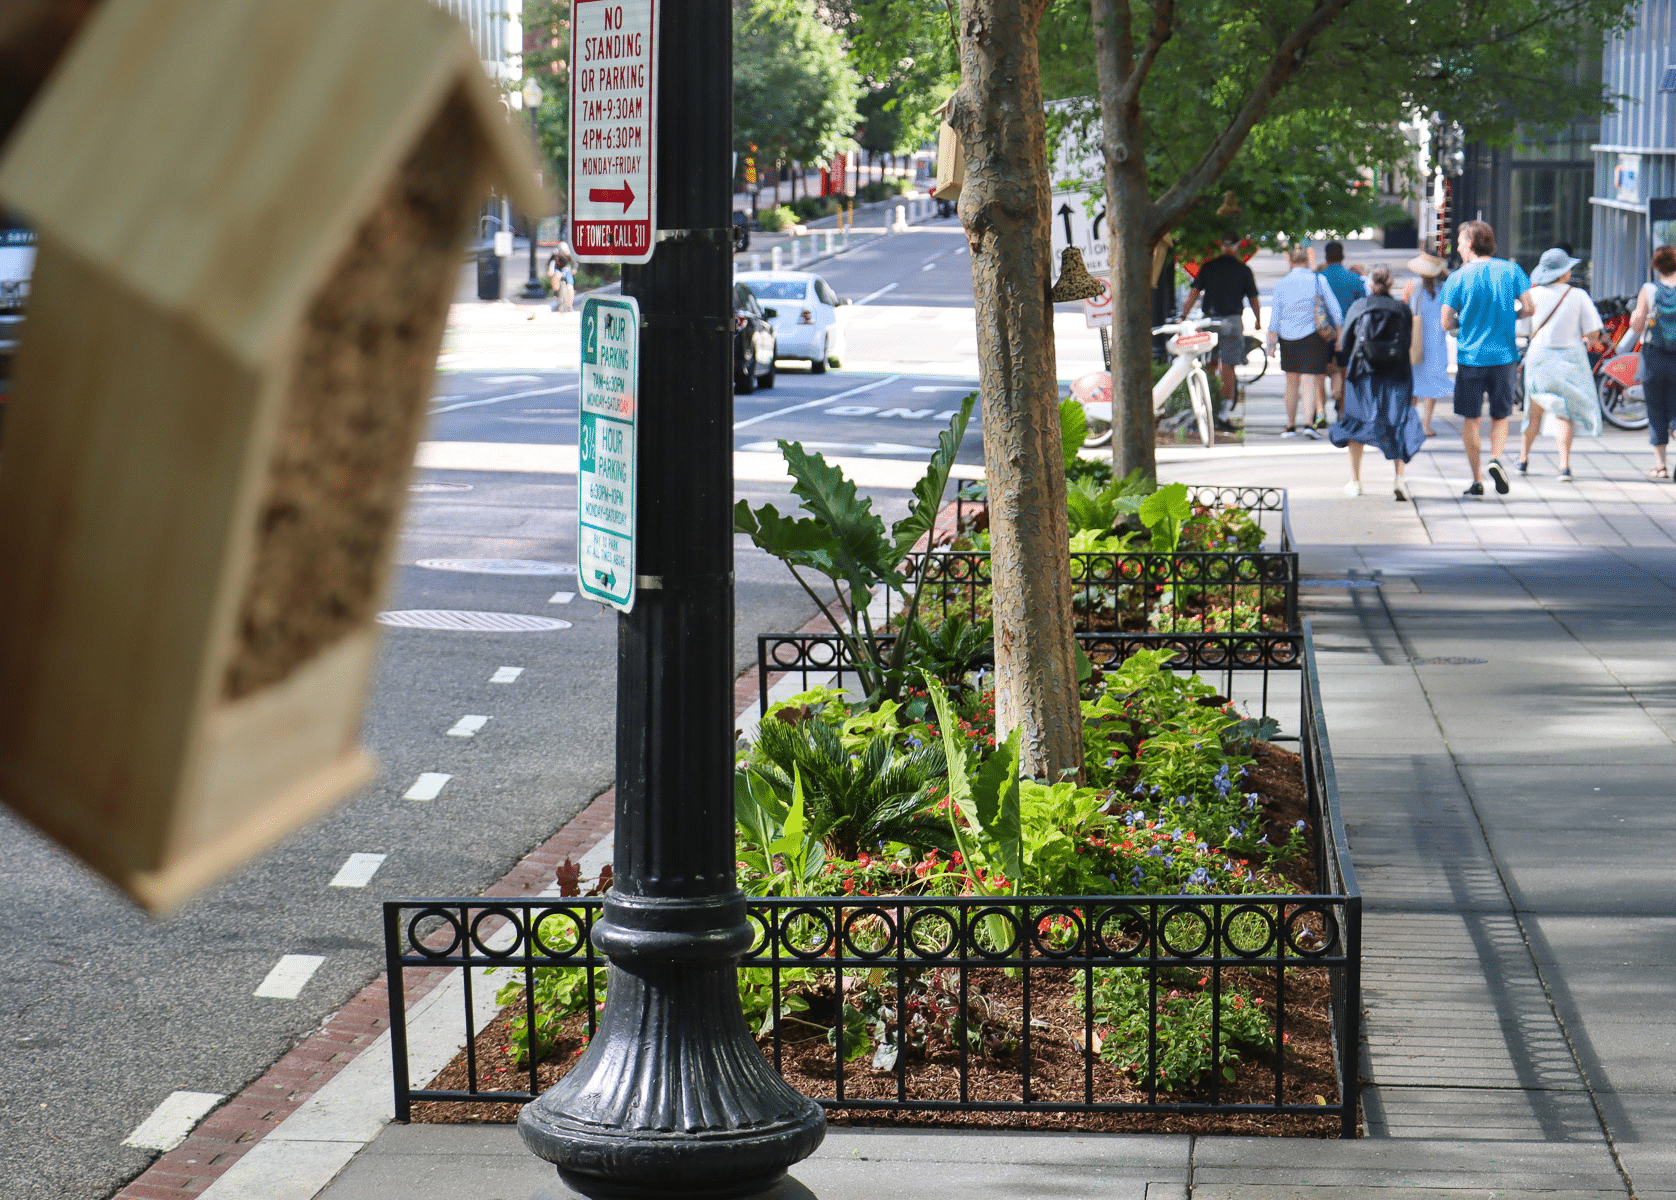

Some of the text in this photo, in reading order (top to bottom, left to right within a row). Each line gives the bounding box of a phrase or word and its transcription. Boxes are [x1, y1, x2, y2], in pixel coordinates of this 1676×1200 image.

[604, 5, 623, 31] NO
[584, 32, 642, 61] STANDING
[581, 64, 644, 92] OR PARKING
[582, 96, 642, 121] 7AM-9:30AM
[582, 126, 642, 150] 4PM-6:30PM
[582, 155, 641, 175] MONDAY-FRIDAY
[576, 224, 646, 247] IF TOWED CALL 311
[587, 315, 626, 353] 2 HOUR
[600, 345, 629, 371] PARKING
[592, 372, 625, 394] 7AM-6:30PM
[602, 426, 623, 455] HOUR
[598, 456, 627, 484] PARKING
[590, 483, 624, 507] 6:30PM-10PM
